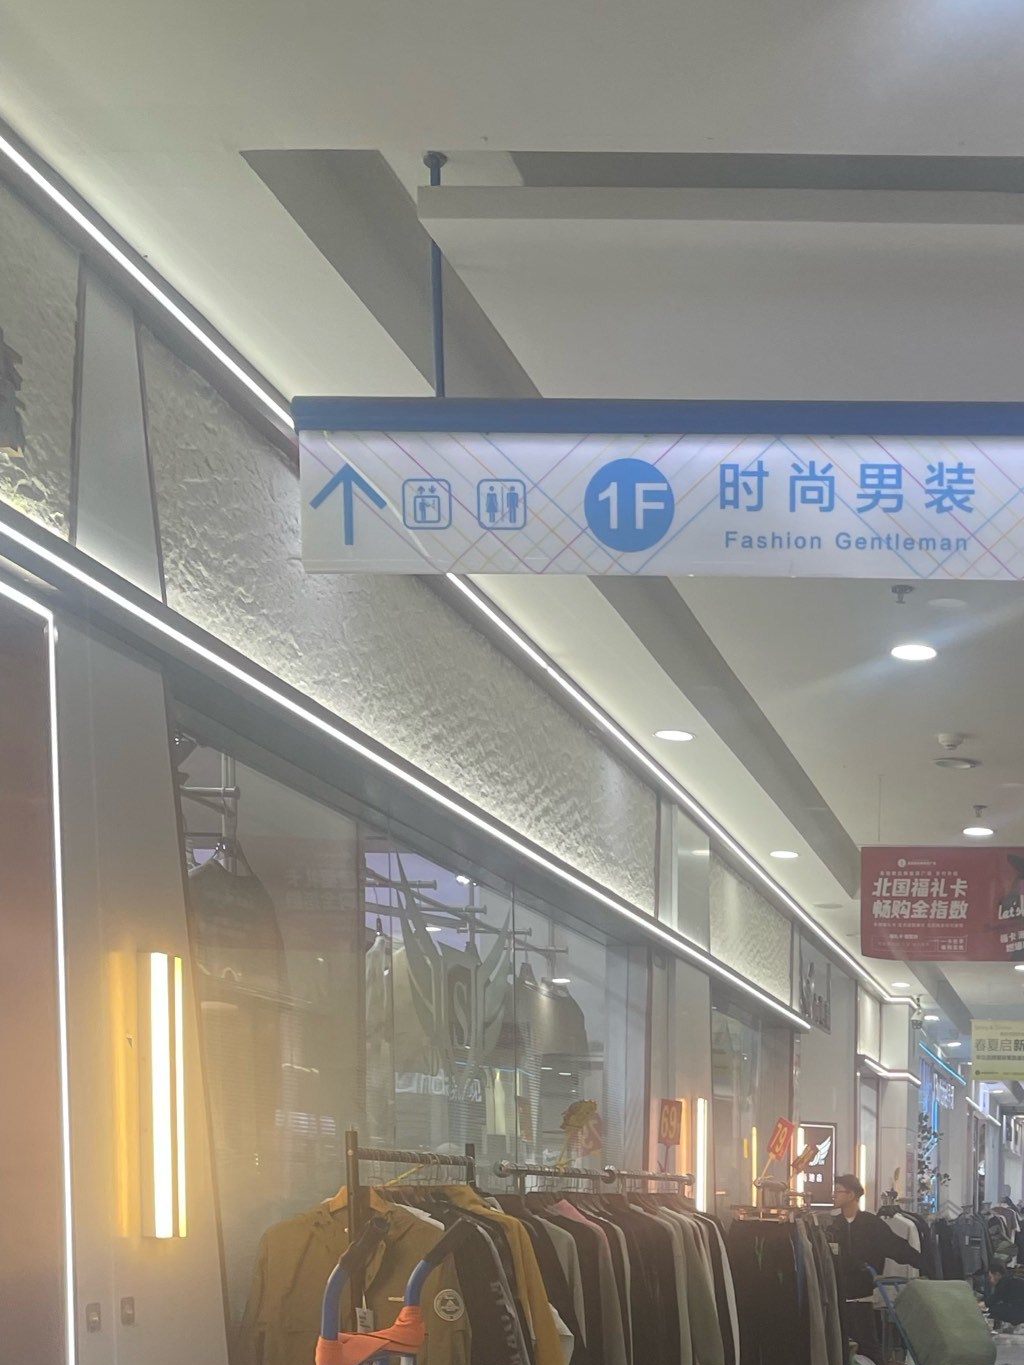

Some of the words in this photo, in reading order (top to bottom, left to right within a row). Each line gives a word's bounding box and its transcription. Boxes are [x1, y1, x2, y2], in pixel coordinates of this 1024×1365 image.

[719, 461, 976, 513] 时尚男装
[598, 481, 668, 531] 1F
[724, 531, 823, 551] Fashion
[836, 533, 969, 553] Gentleman
[872, 878, 968, 898] 北国福礼卡
[872, 900, 968, 919] 畅购金指数
